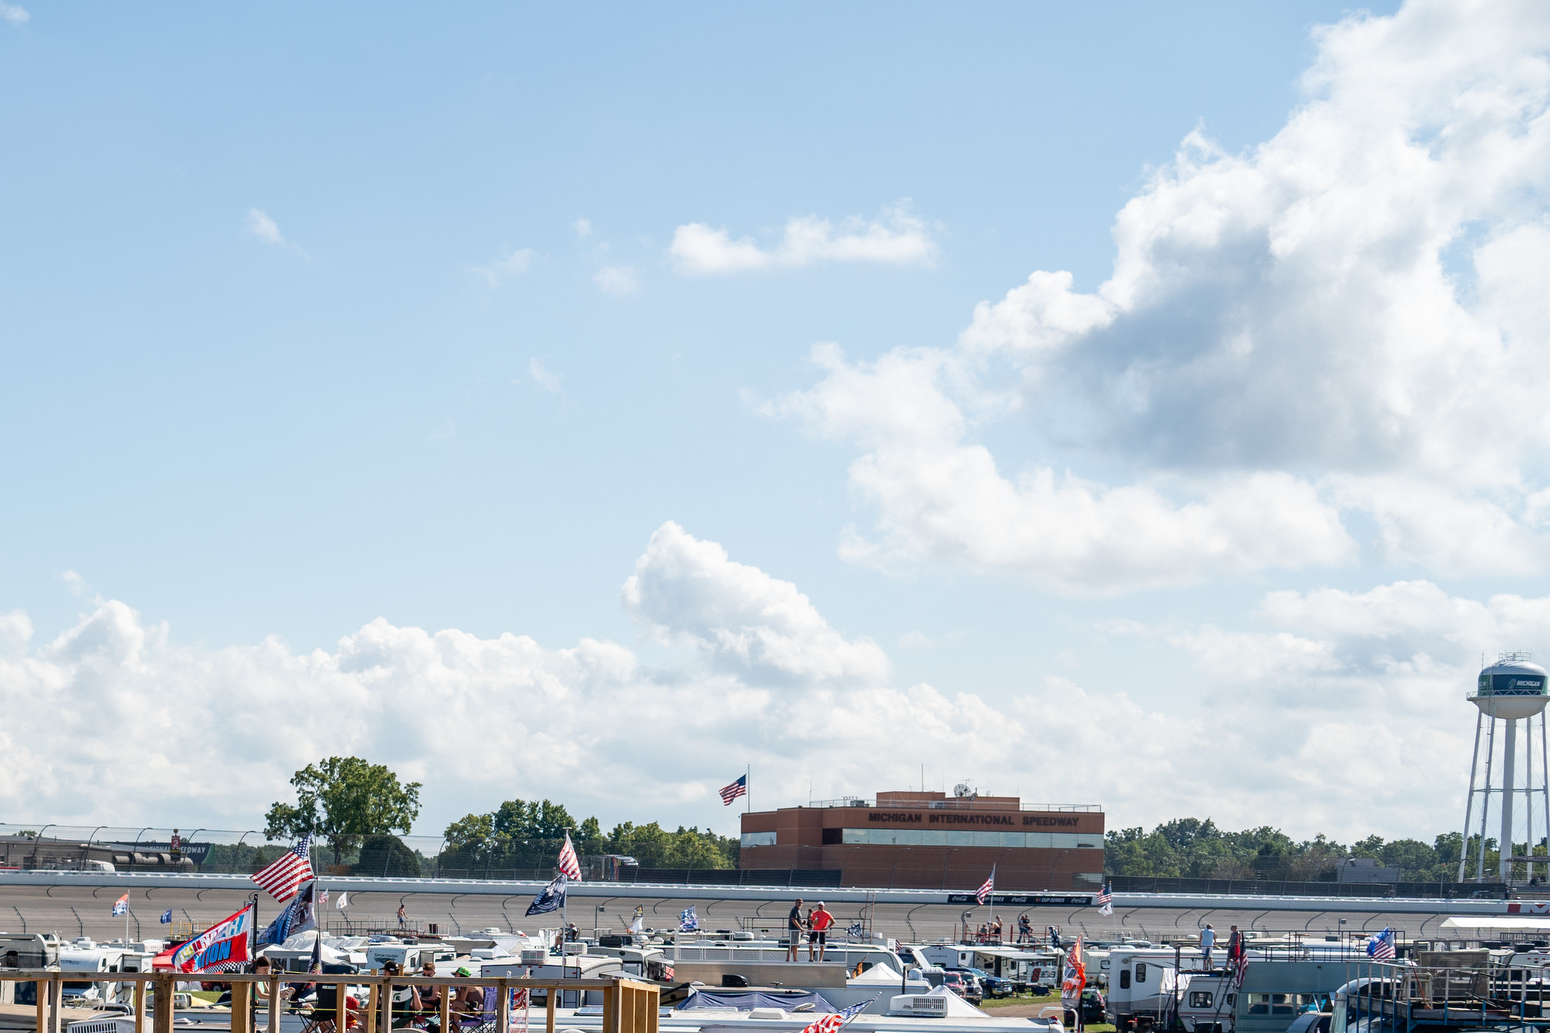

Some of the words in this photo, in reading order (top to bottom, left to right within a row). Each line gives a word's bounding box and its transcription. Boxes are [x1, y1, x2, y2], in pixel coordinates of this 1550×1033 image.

[869, 812, 922, 823] MICHIGAN
[929, 814, 1014, 826] INTERNATIONAL
[1022, 816, 1079, 827] SPEEDWAY
[173, 839, 179, 848] 2
